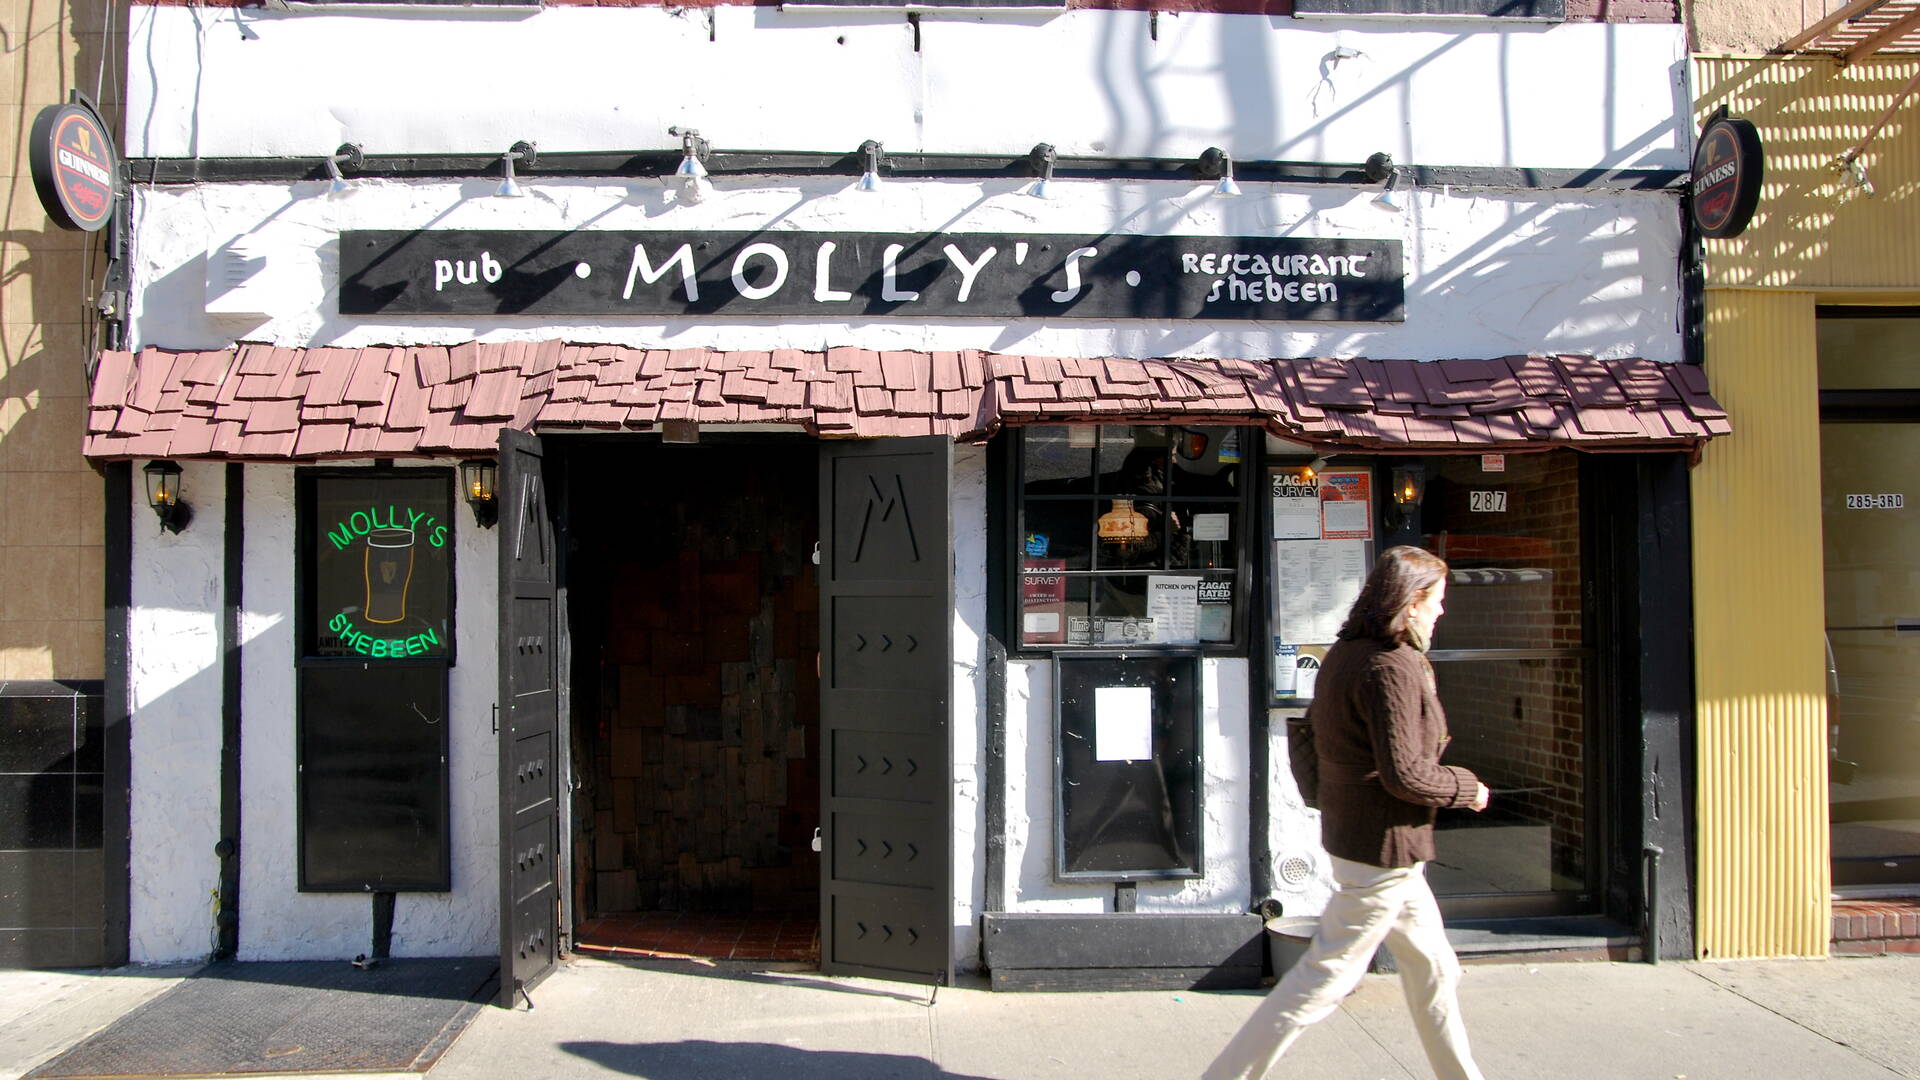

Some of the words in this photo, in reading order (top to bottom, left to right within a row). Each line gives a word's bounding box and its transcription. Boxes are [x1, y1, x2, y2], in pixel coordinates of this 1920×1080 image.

[59, 149, 110, 187] GUINNESS
[434, 251, 502, 292] pub
[622, 241, 1098, 304] MOLLY'S
[1273, 486, 1318, 497] SURVEY
[1472, 492, 1505, 511] 287
[1848, 495, 1902, 508] 285-3RD
[327, 505, 448, 550] MOLLY'S
[1024, 576, 1061, 586] SURVEY
[1198, 581, 1231, 590] ZAGAT
[1198, 589, 1231, 598] RATED
[1071, 617, 1090, 632] Time
[329, 613, 439, 658] SHEBEEN
